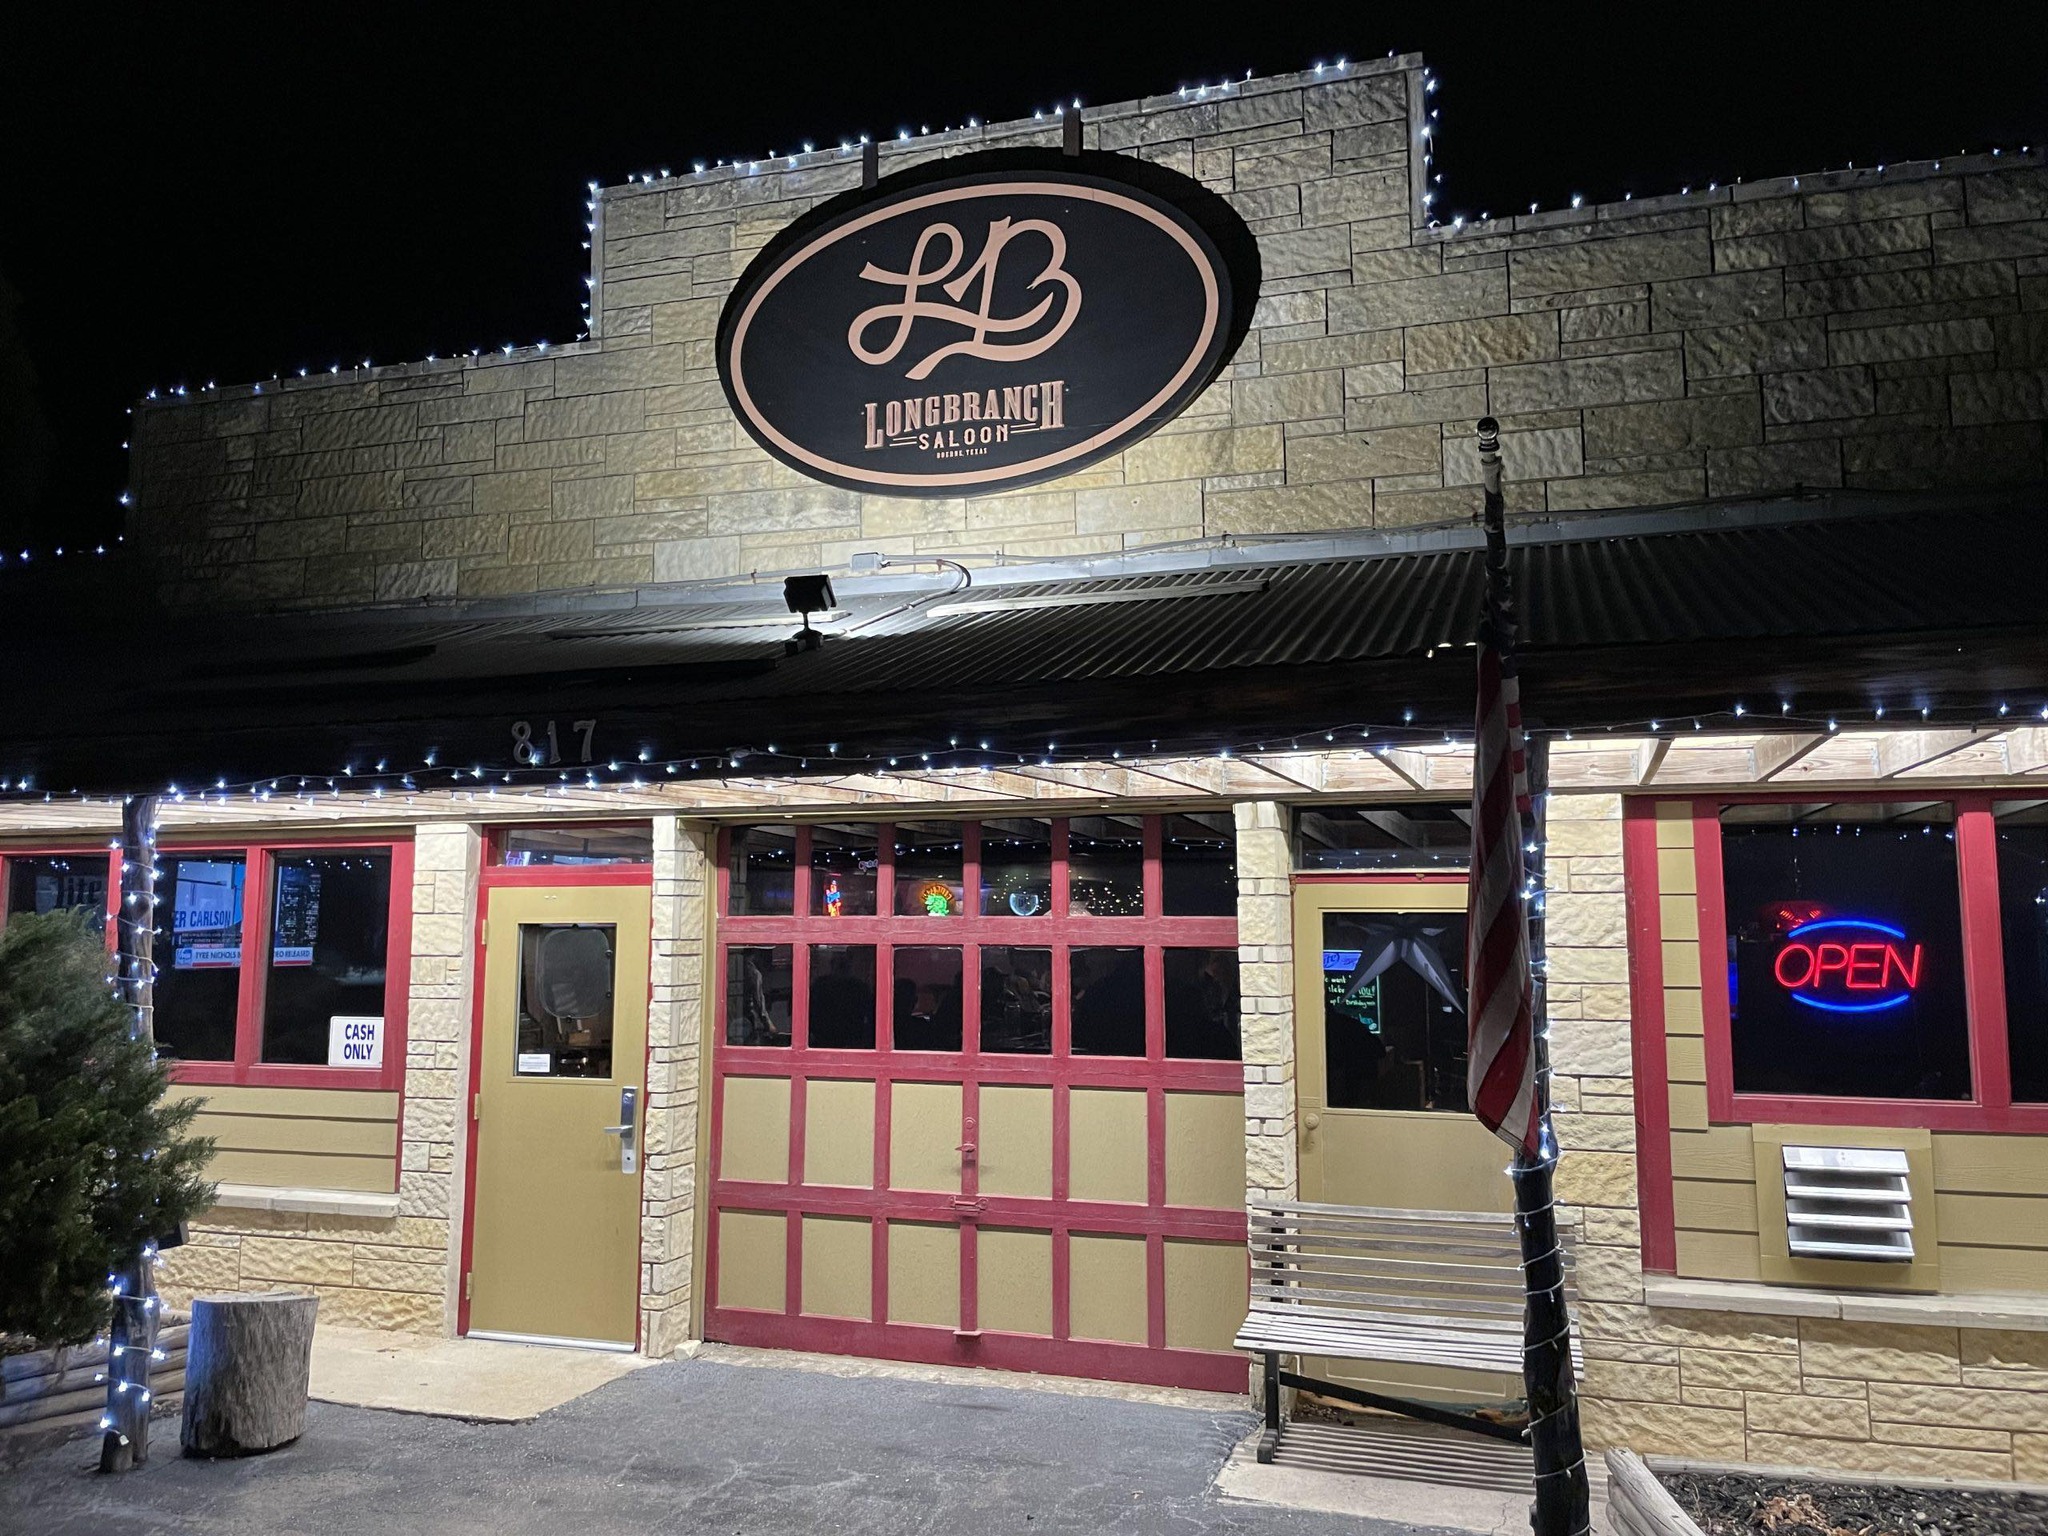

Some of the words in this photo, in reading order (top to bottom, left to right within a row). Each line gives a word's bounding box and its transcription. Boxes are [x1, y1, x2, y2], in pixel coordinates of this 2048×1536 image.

[848, 216, 1082, 380] LB
[864, 380, 1065, 449] LONGBRANCH
[918, 424, 1009, 450] SALOON
[965, 447, 987, 456] TEXAS
[511, 719, 597, 764] 817
[189, 910, 231, 927] CARLSON
[210, 951, 237, 959] NICHOLS
[1775, 943, 1921, 988] OPEN
[345, 1024, 375, 1040] CASH
[344, 1043, 374, 1060] ONLY
